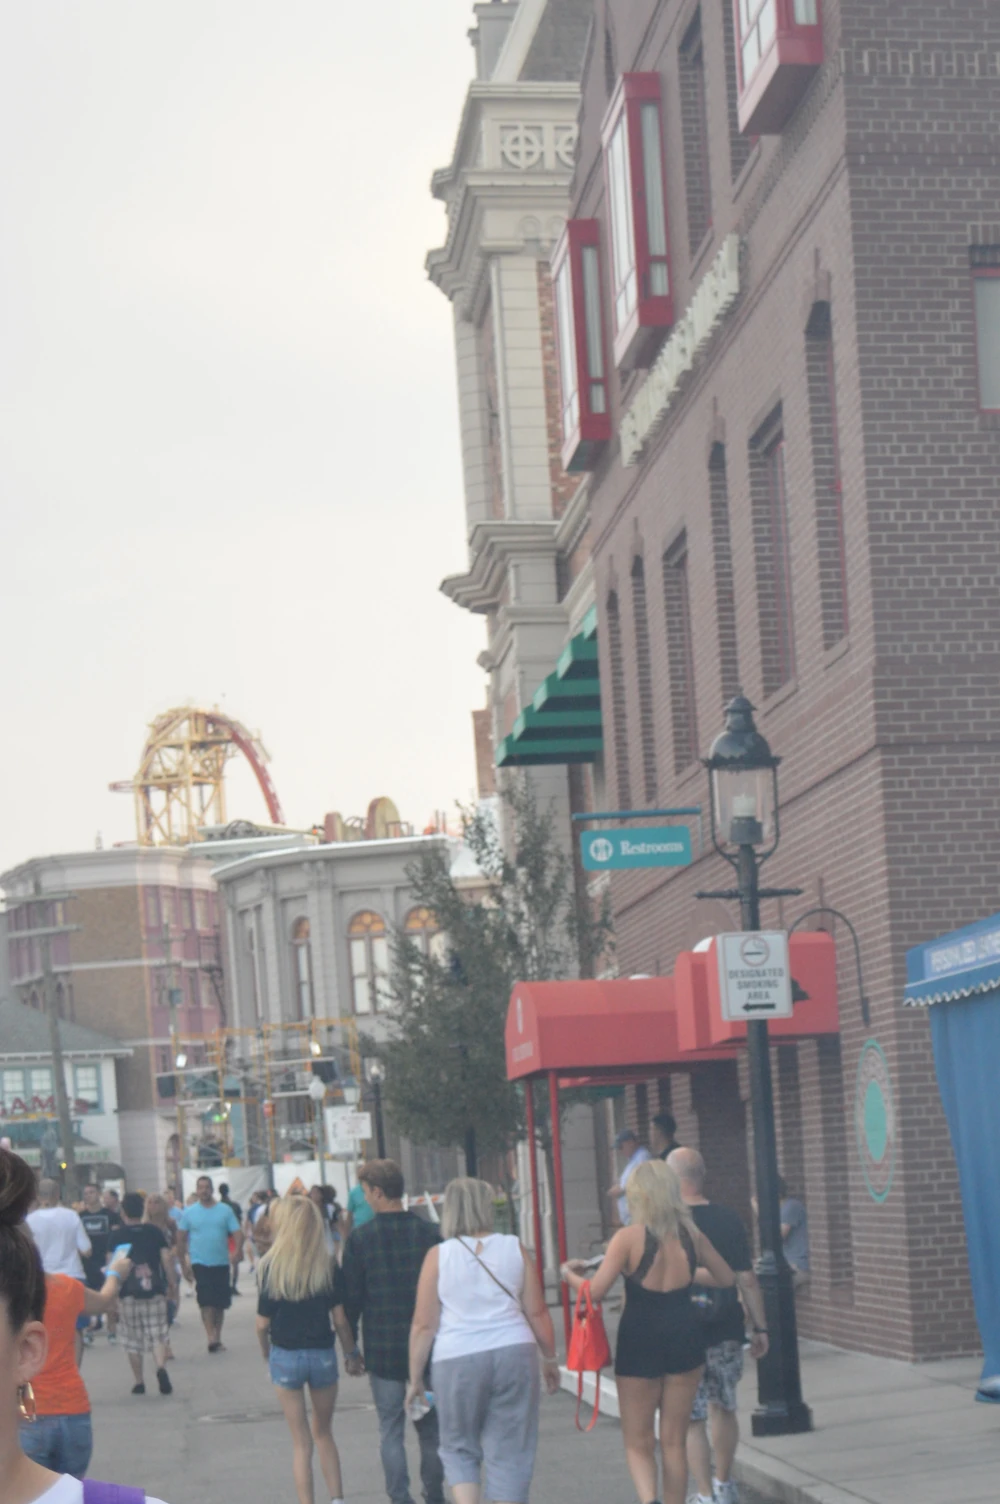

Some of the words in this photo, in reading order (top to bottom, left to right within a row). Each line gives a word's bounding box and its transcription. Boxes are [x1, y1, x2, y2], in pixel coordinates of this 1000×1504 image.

[620, 840, 684, 856] Restrooms
[728, 968, 784, 980] DESIGNATED
[737, 979, 779, 990] SMOKING
[747, 991, 771, 1000] AREA
